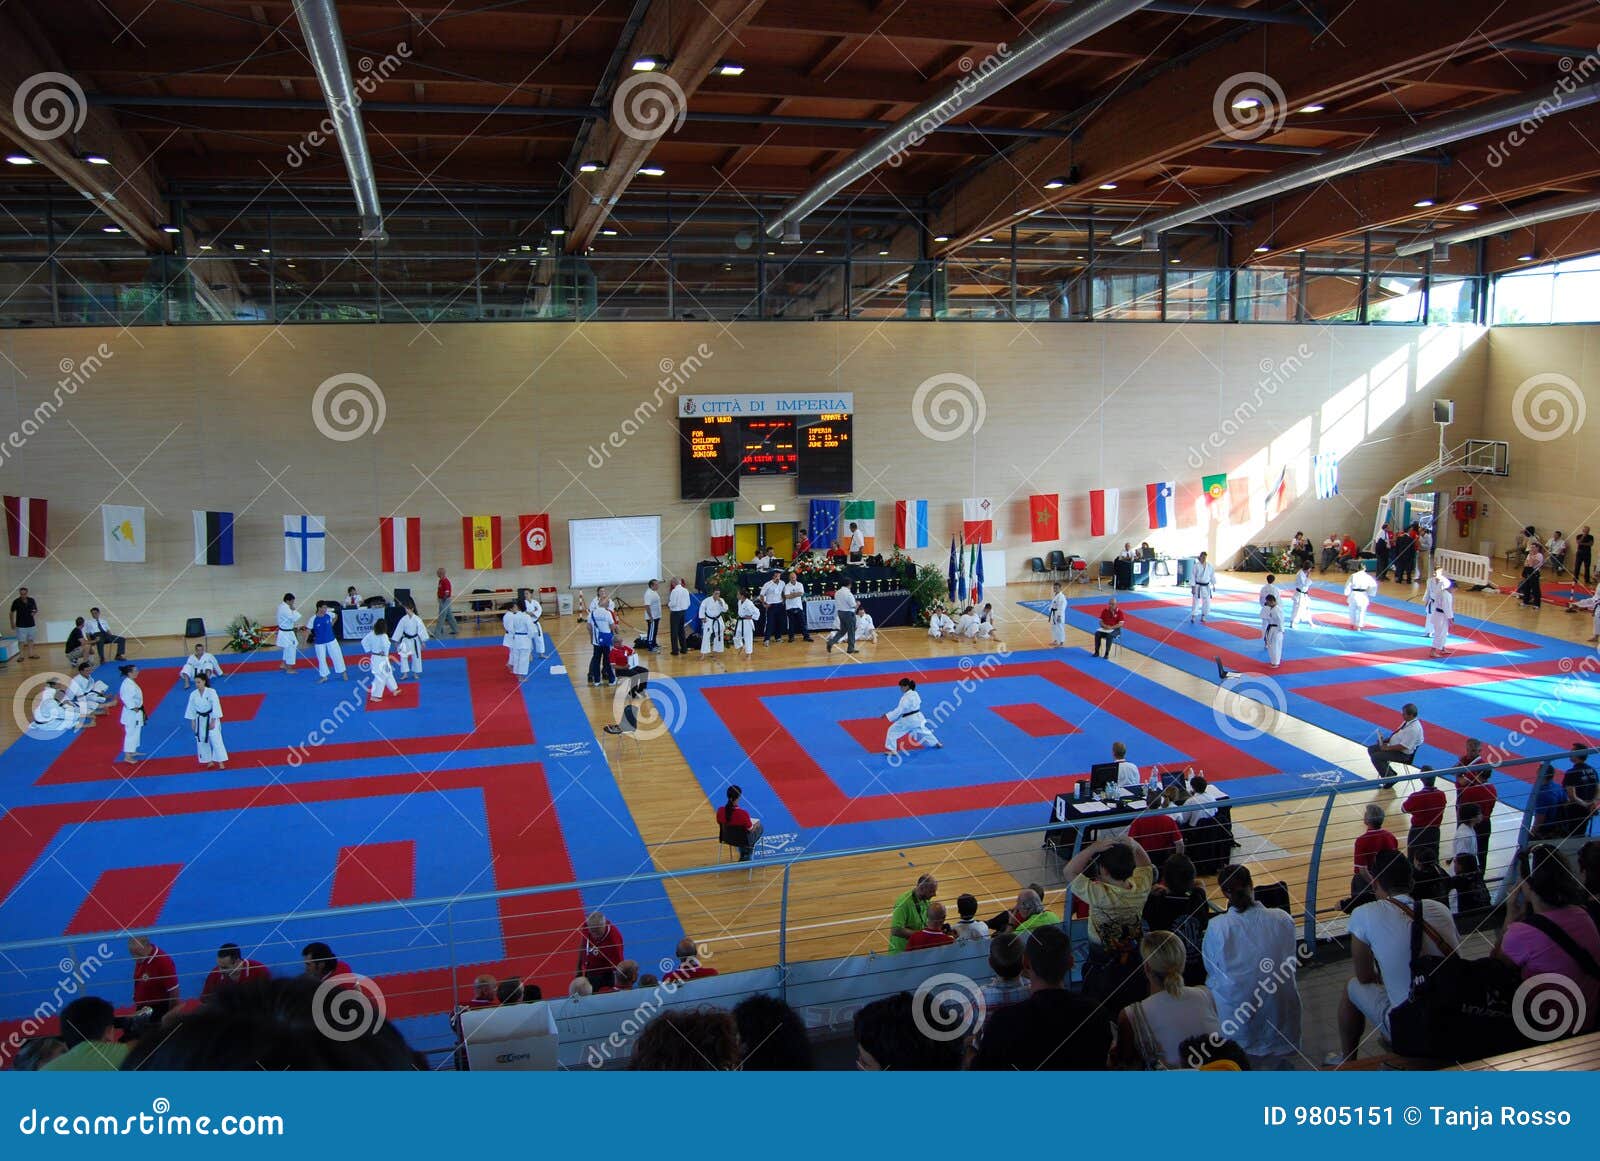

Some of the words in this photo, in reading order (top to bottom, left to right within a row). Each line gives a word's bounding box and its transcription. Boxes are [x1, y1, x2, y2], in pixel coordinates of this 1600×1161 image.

[702, 398, 742, 413] CITTÀ
[750, 401, 765, 412] DI
[777, 399, 848, 411] IMPERIA
[691, 430, 704, 438] FOR
[692, 450, 718, 458] JUNIORS
